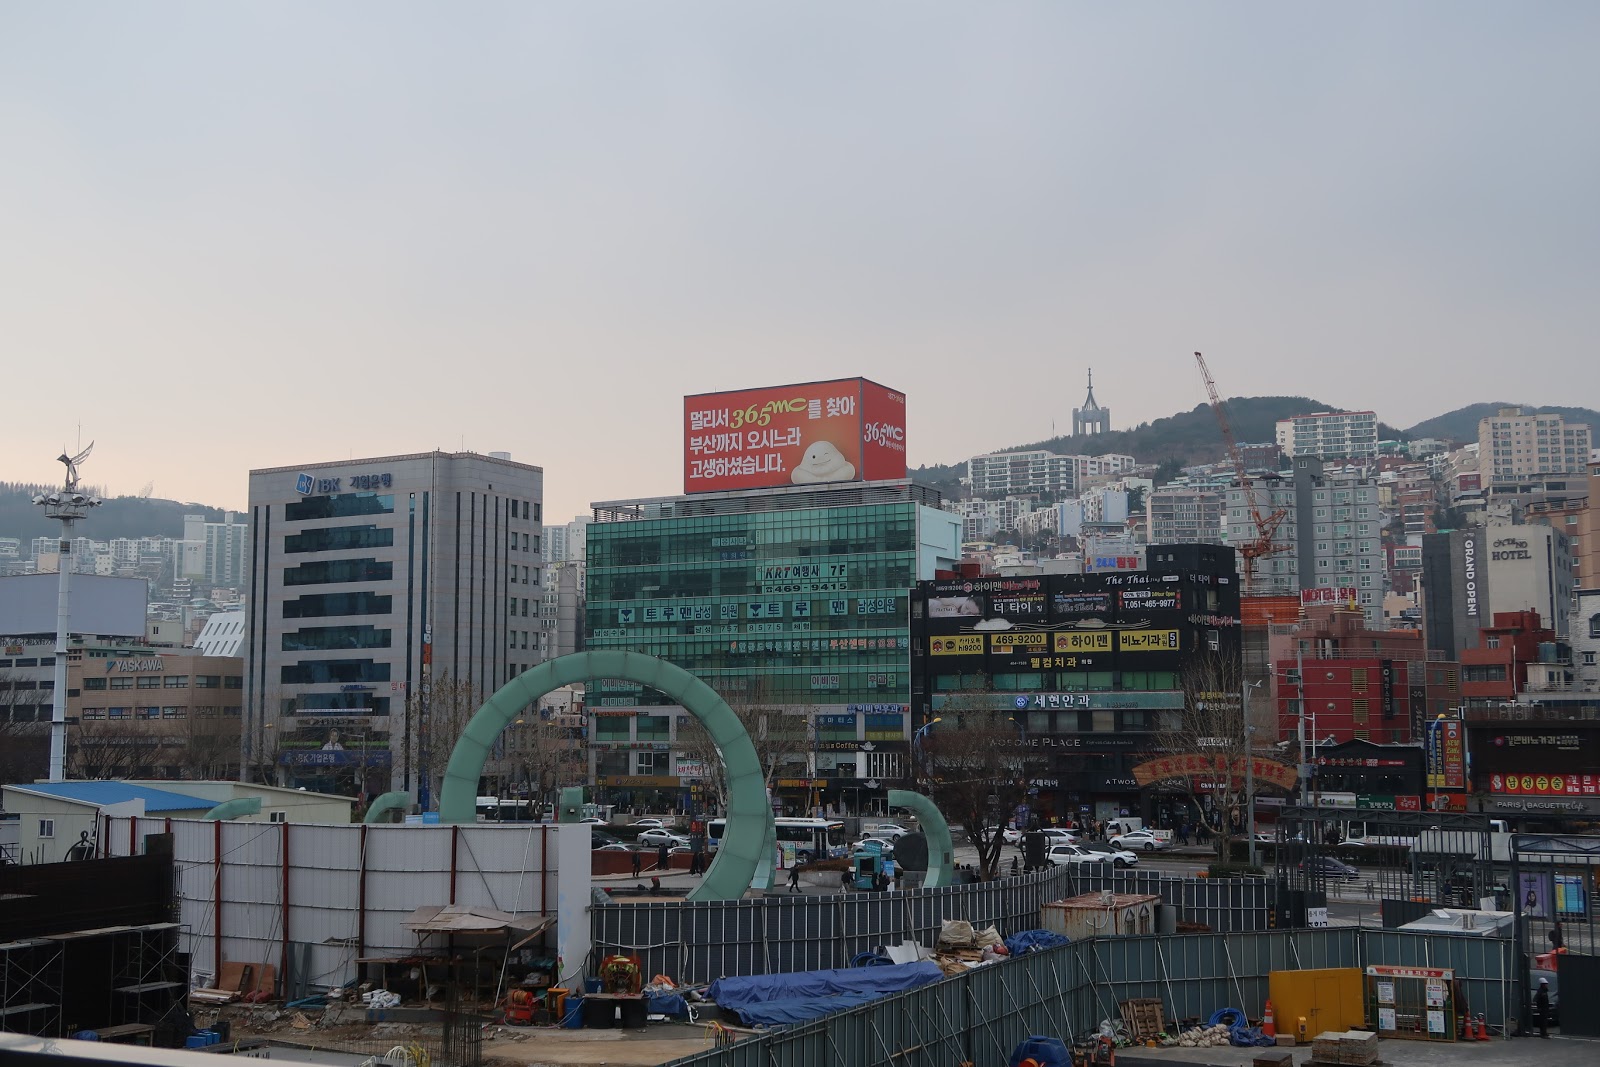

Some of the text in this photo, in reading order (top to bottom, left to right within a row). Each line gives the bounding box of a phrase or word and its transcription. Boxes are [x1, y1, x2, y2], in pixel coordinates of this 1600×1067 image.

[691, 409, 729, 430] 멀리서
[826, 395, 855, 417] 찾아
[690, 427, 801, 455] 부산까지 오시느라
[690, 453, 786, 479] 고생하셨습니다.
[317, 473, 392, 493] IBK 기업은행
[1464, 540, 1475, 579] GRAND
[1492, 550, 1532, 560] HOTEL
[1106, 576, 1122, 584] The
[1127, 575, 1150, 584] Thai
[994, 602, 1004, 614] 더
[1010, 602, 1030, 613] 타이
[996, 635, 1042, 644] 469-9200
[1071, 634, 1108, 648] 하이맨
[1122, 634, 1160, 646] 비뇨기과
[116, 659, 164, 672] YASKAWA
[1030, 657, 1077, 668] 웰컴치과
[1034, 695, 1090, 708] 세현안과
[1042, 738, 1081, 747] PLACE
[310, 753, 335, 763] 기업은행
